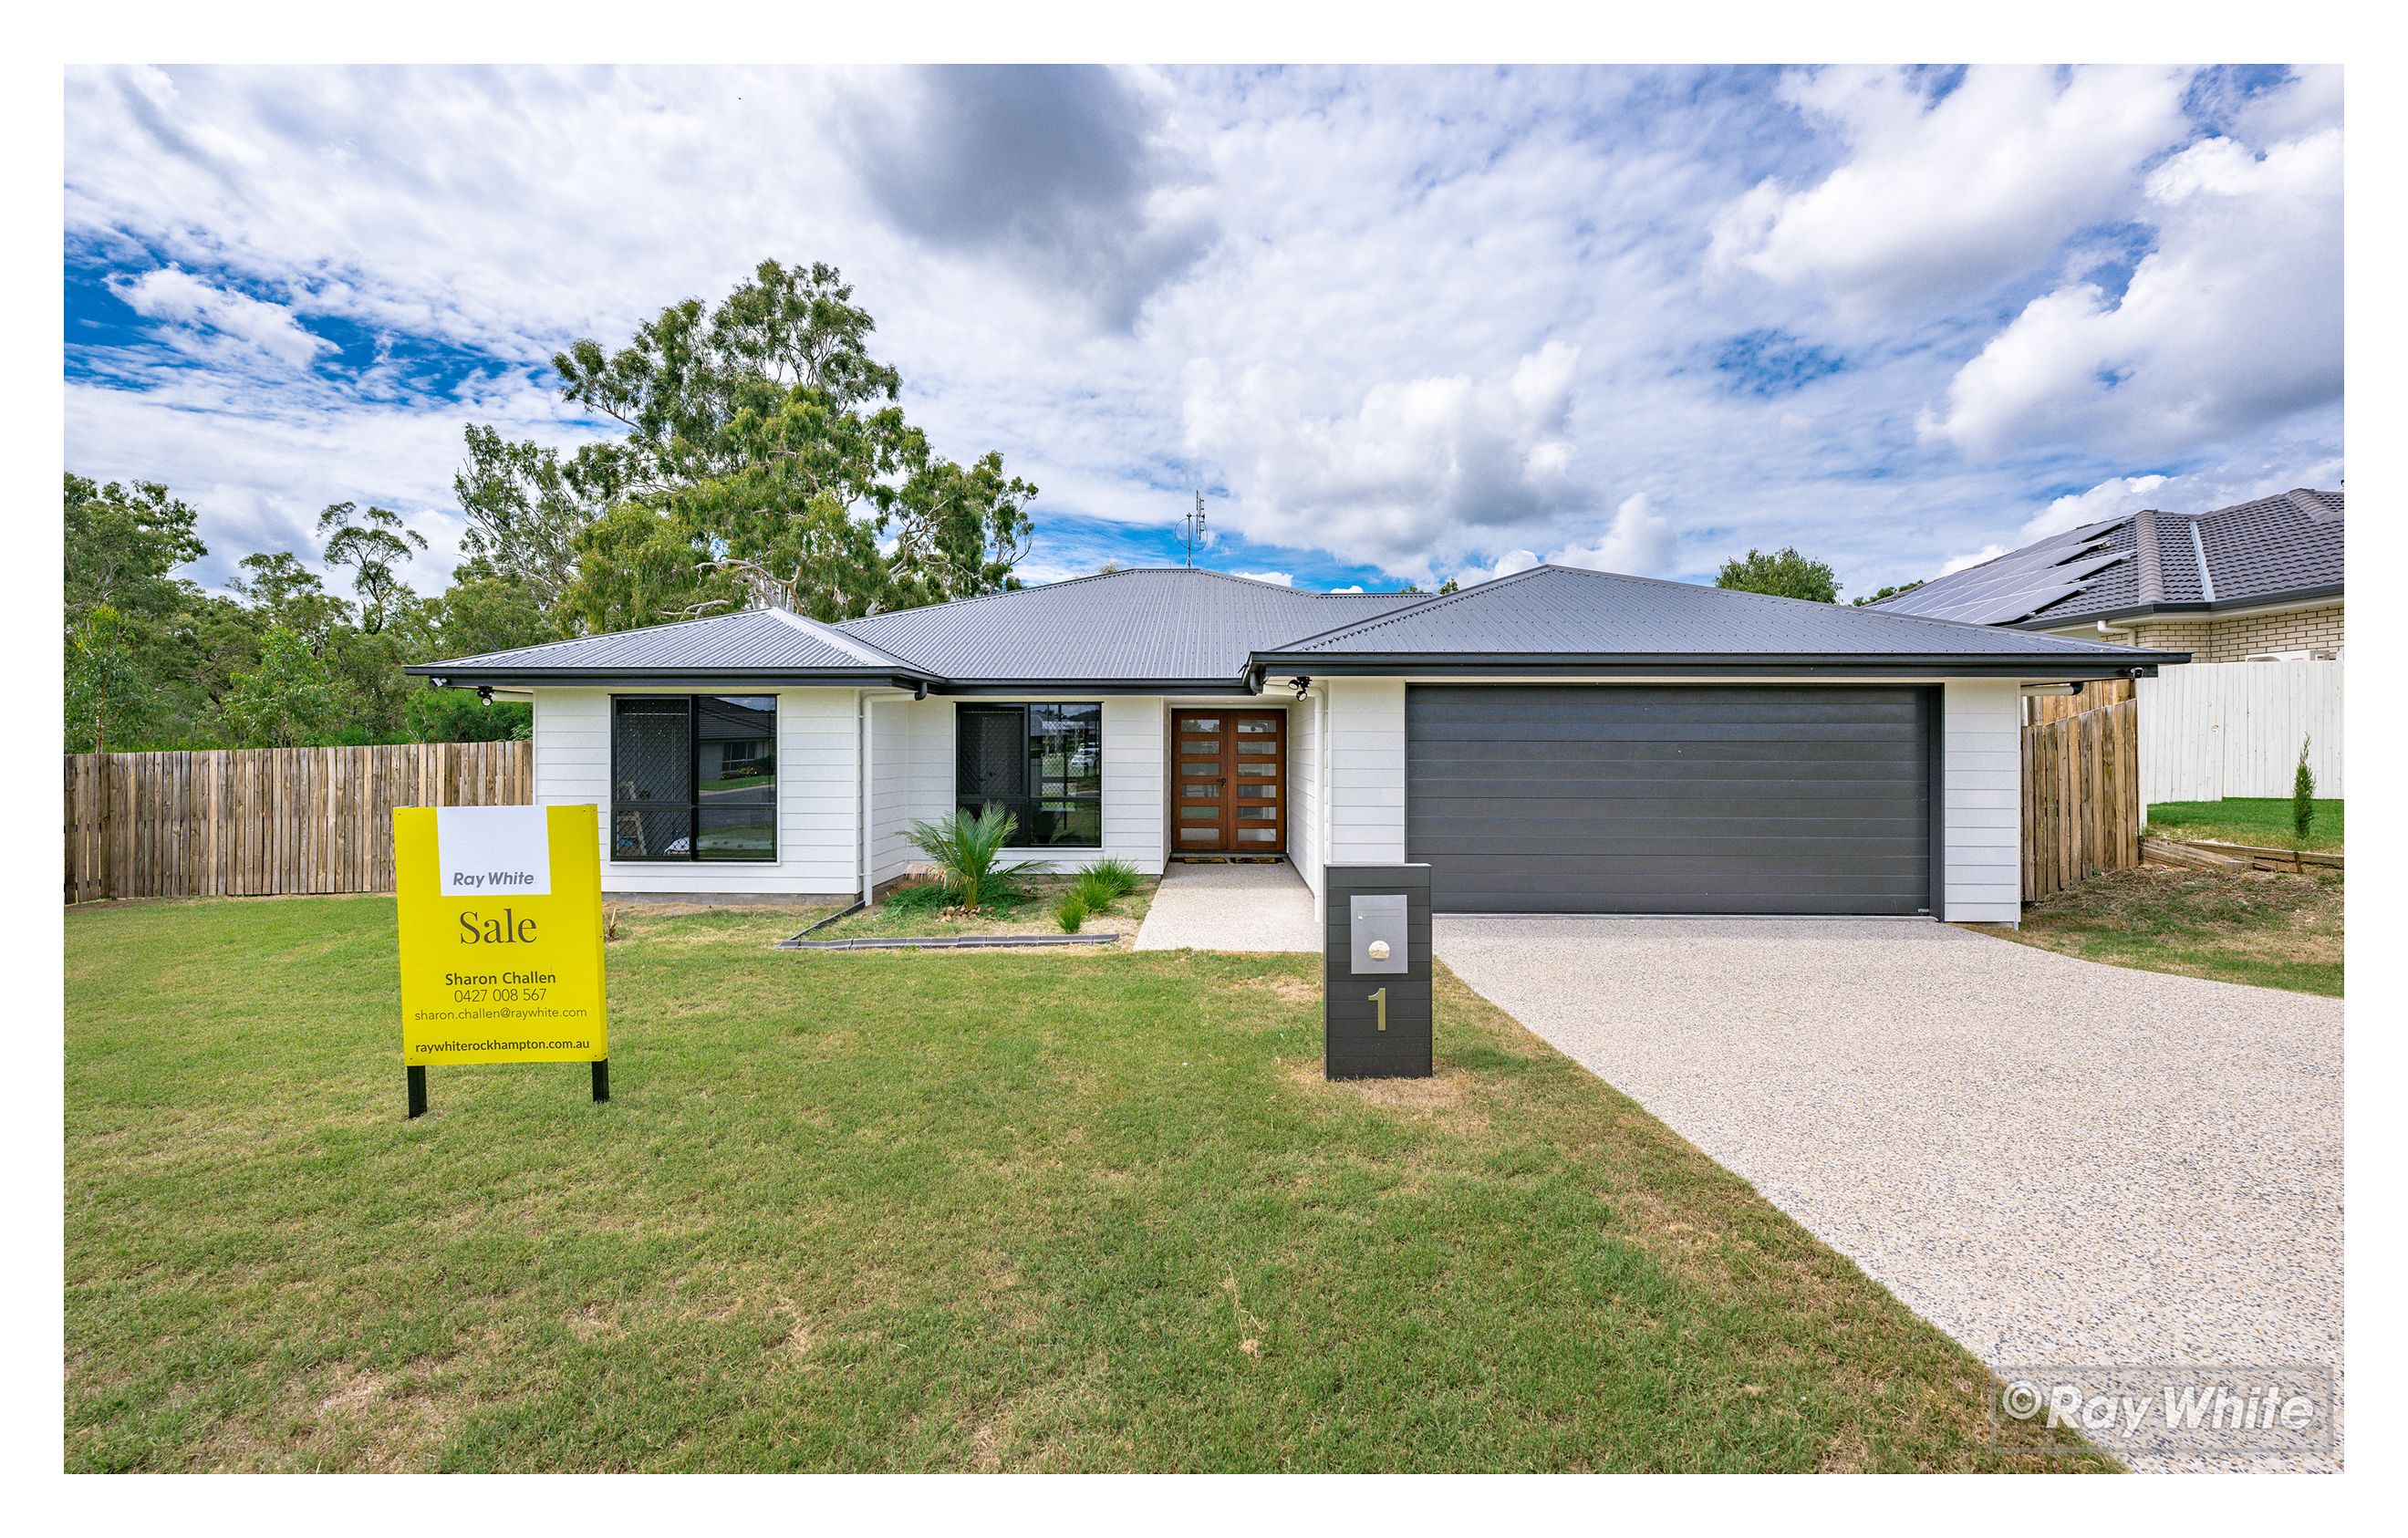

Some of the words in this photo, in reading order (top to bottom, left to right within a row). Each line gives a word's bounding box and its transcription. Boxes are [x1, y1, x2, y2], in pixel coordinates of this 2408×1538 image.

[453, 871, 485, 888] Ray
[488, 871, 535, 885] White
[460, 909, 537, 944] Sale
[445, 972, 497, 985] Sharon
[503, 972, 556, 984] Challen
[454, 990, 487, 1003] 0427
[493, 989, 518, 1002] 008
[523, 988, 547, 1001] 567
[414, 1007, 587, 1021] sharon.challen@raywhite.com
[1368, 988, 1386, 1031] 1
[415, 1040, 590, 1053] raywhiterockhampton.com.au
